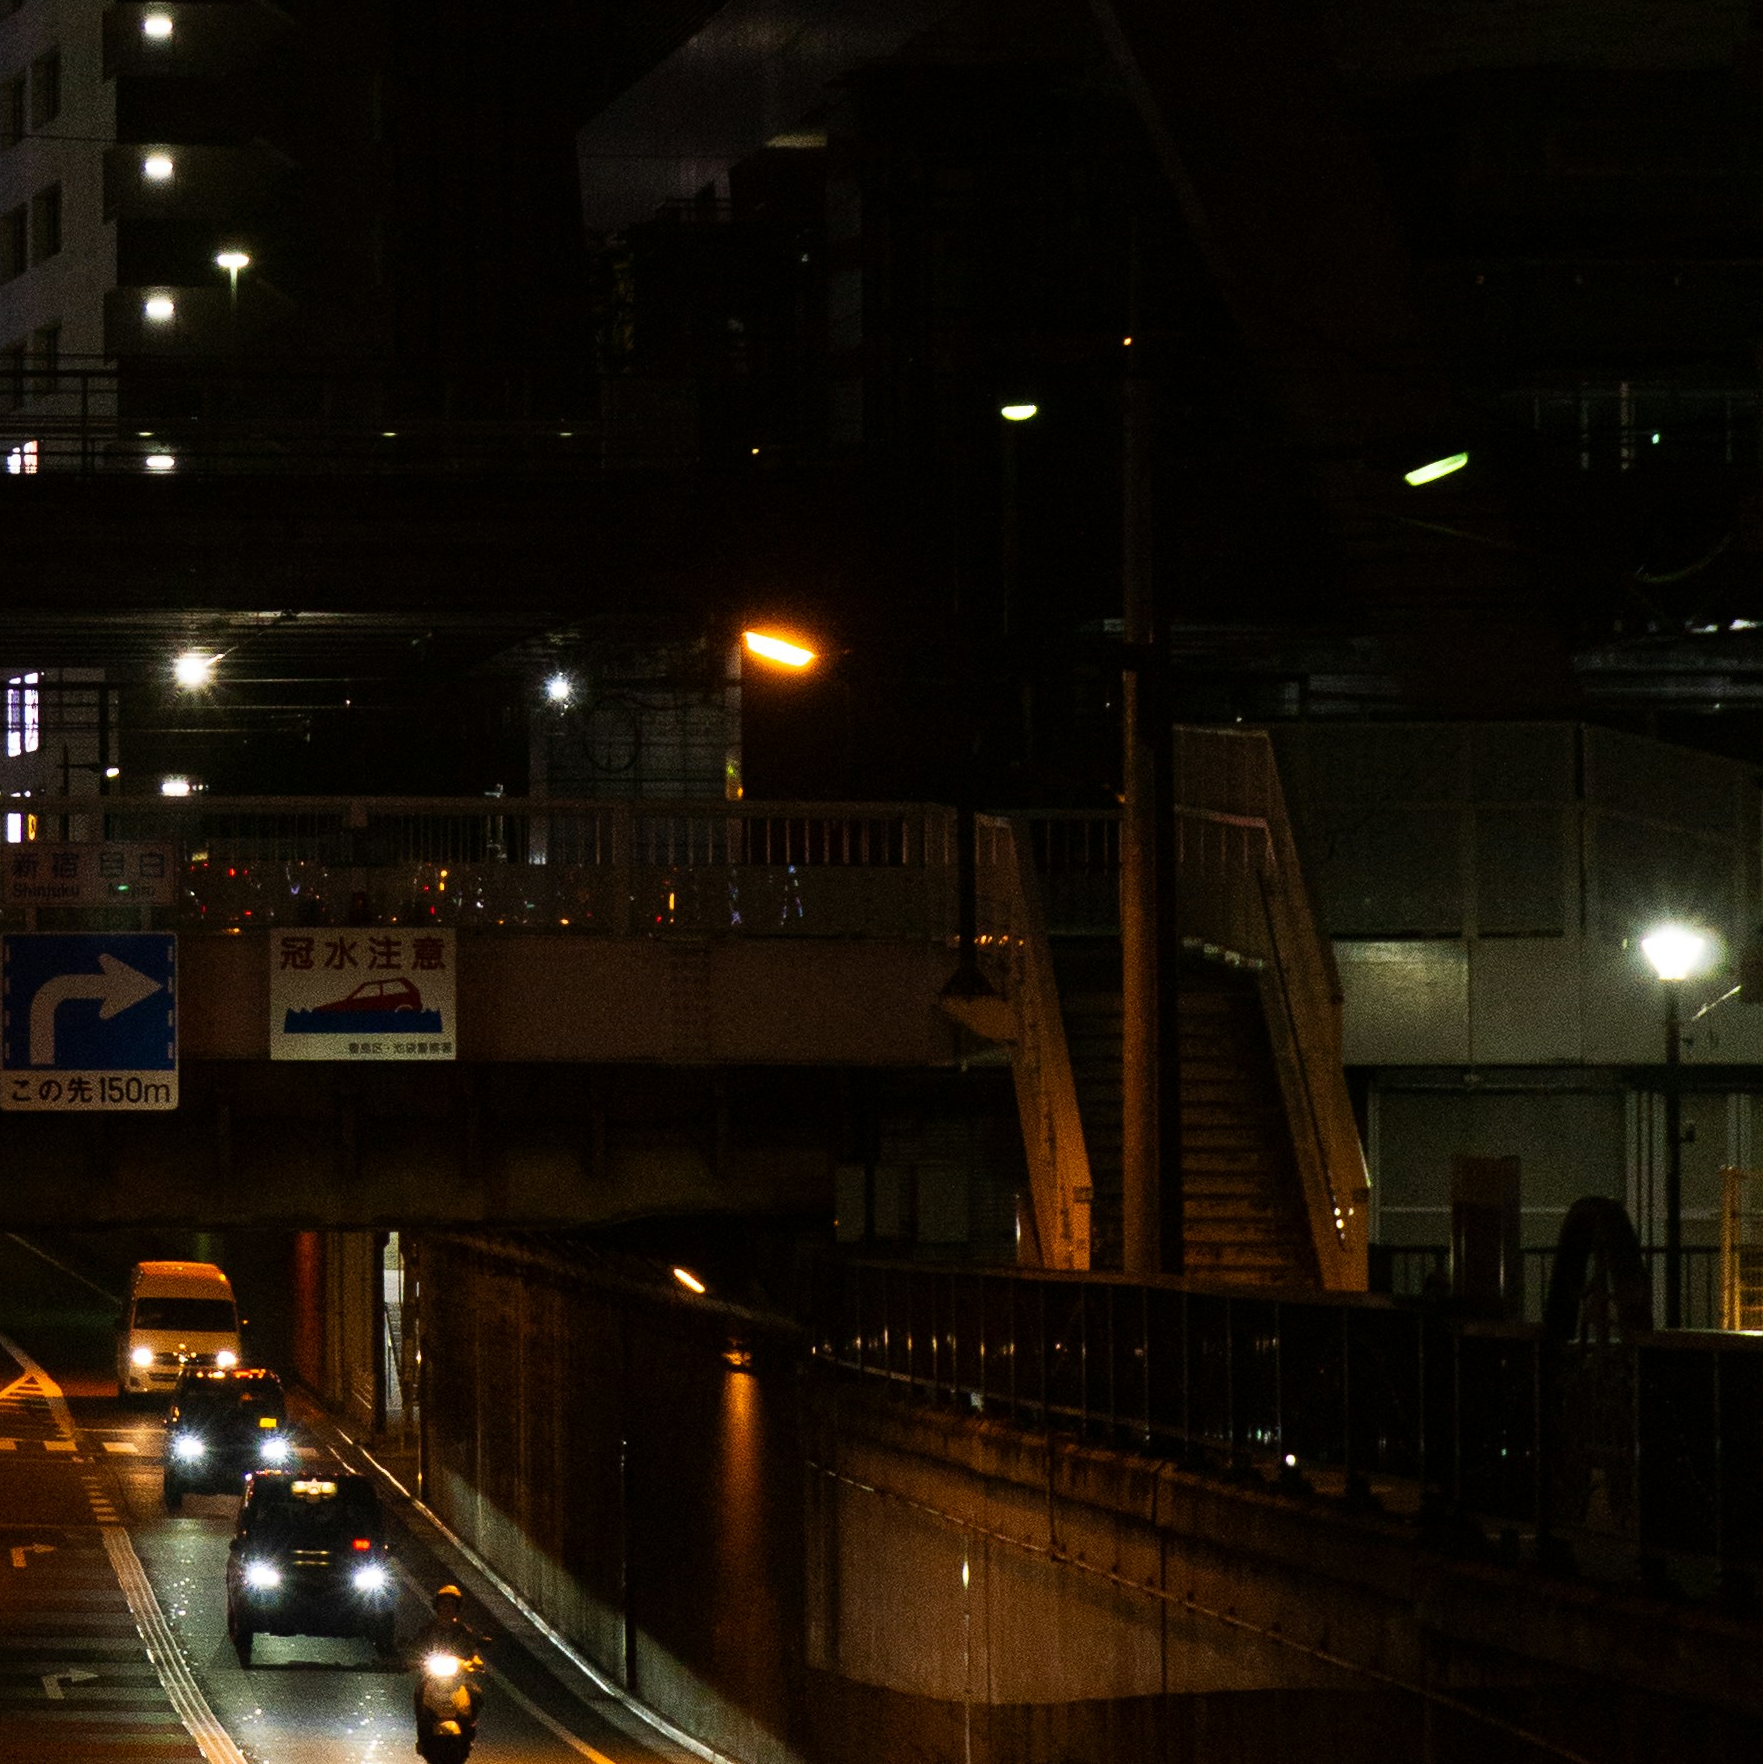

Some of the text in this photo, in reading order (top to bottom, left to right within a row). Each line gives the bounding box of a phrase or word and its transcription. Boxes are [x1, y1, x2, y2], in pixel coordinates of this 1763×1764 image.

[12, 851, 166, 879] 新宿 目白
[12, 883, 156, 899] Shinjuku Mjiro
[280, 936, 446, 971] 冠水注意
[11, 1076, 172, 1104] この先150m
